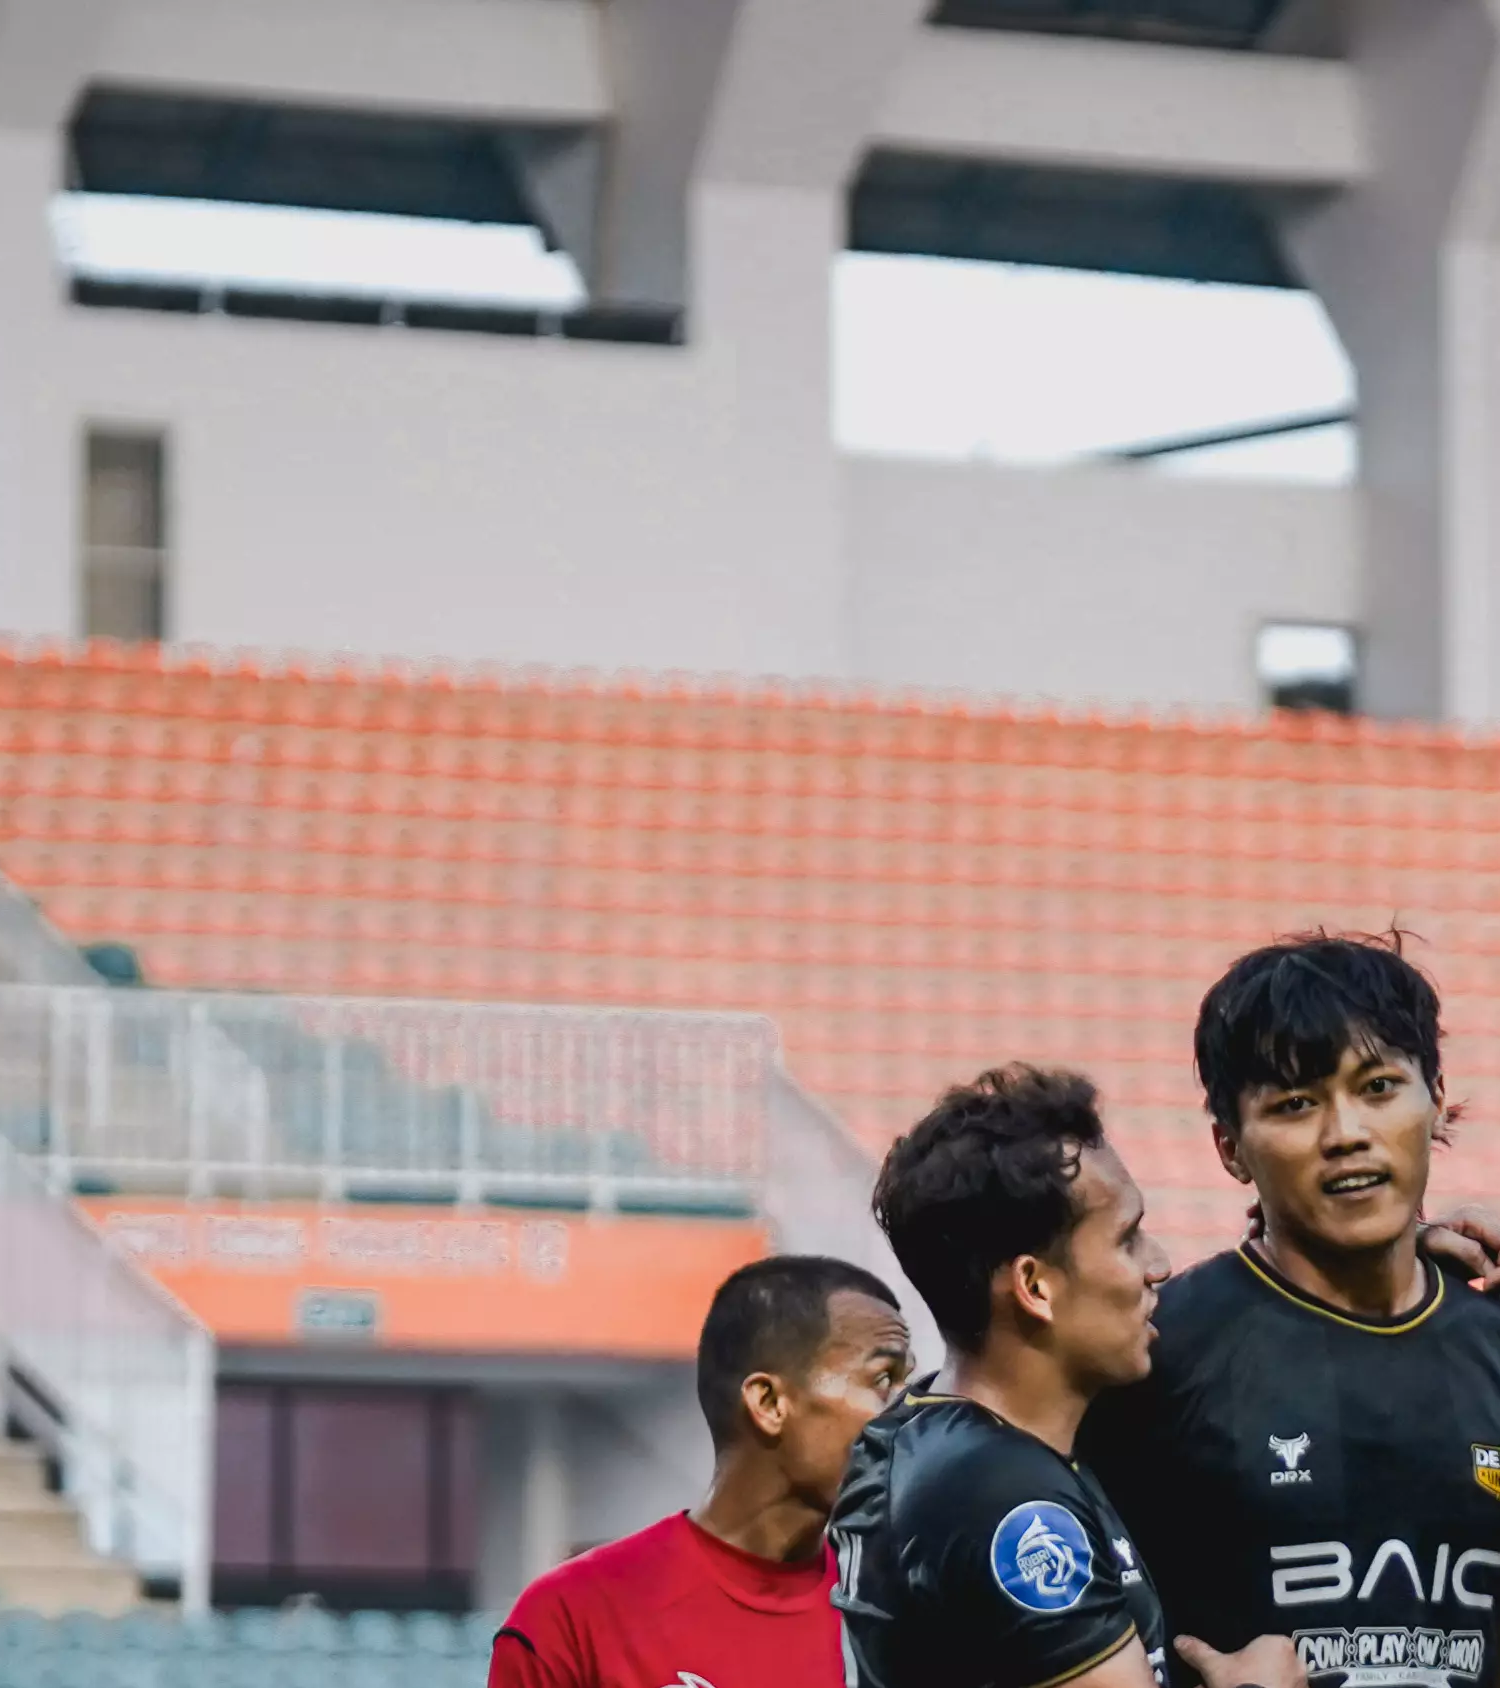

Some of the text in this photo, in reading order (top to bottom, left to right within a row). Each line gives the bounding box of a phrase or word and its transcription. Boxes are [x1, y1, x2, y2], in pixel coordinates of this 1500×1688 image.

[1270, 1469, 1312, 1485] DRX
[1298, 1635, 1346, 1671] COW
[1358, 1634, 1407, 1664] PLAY
